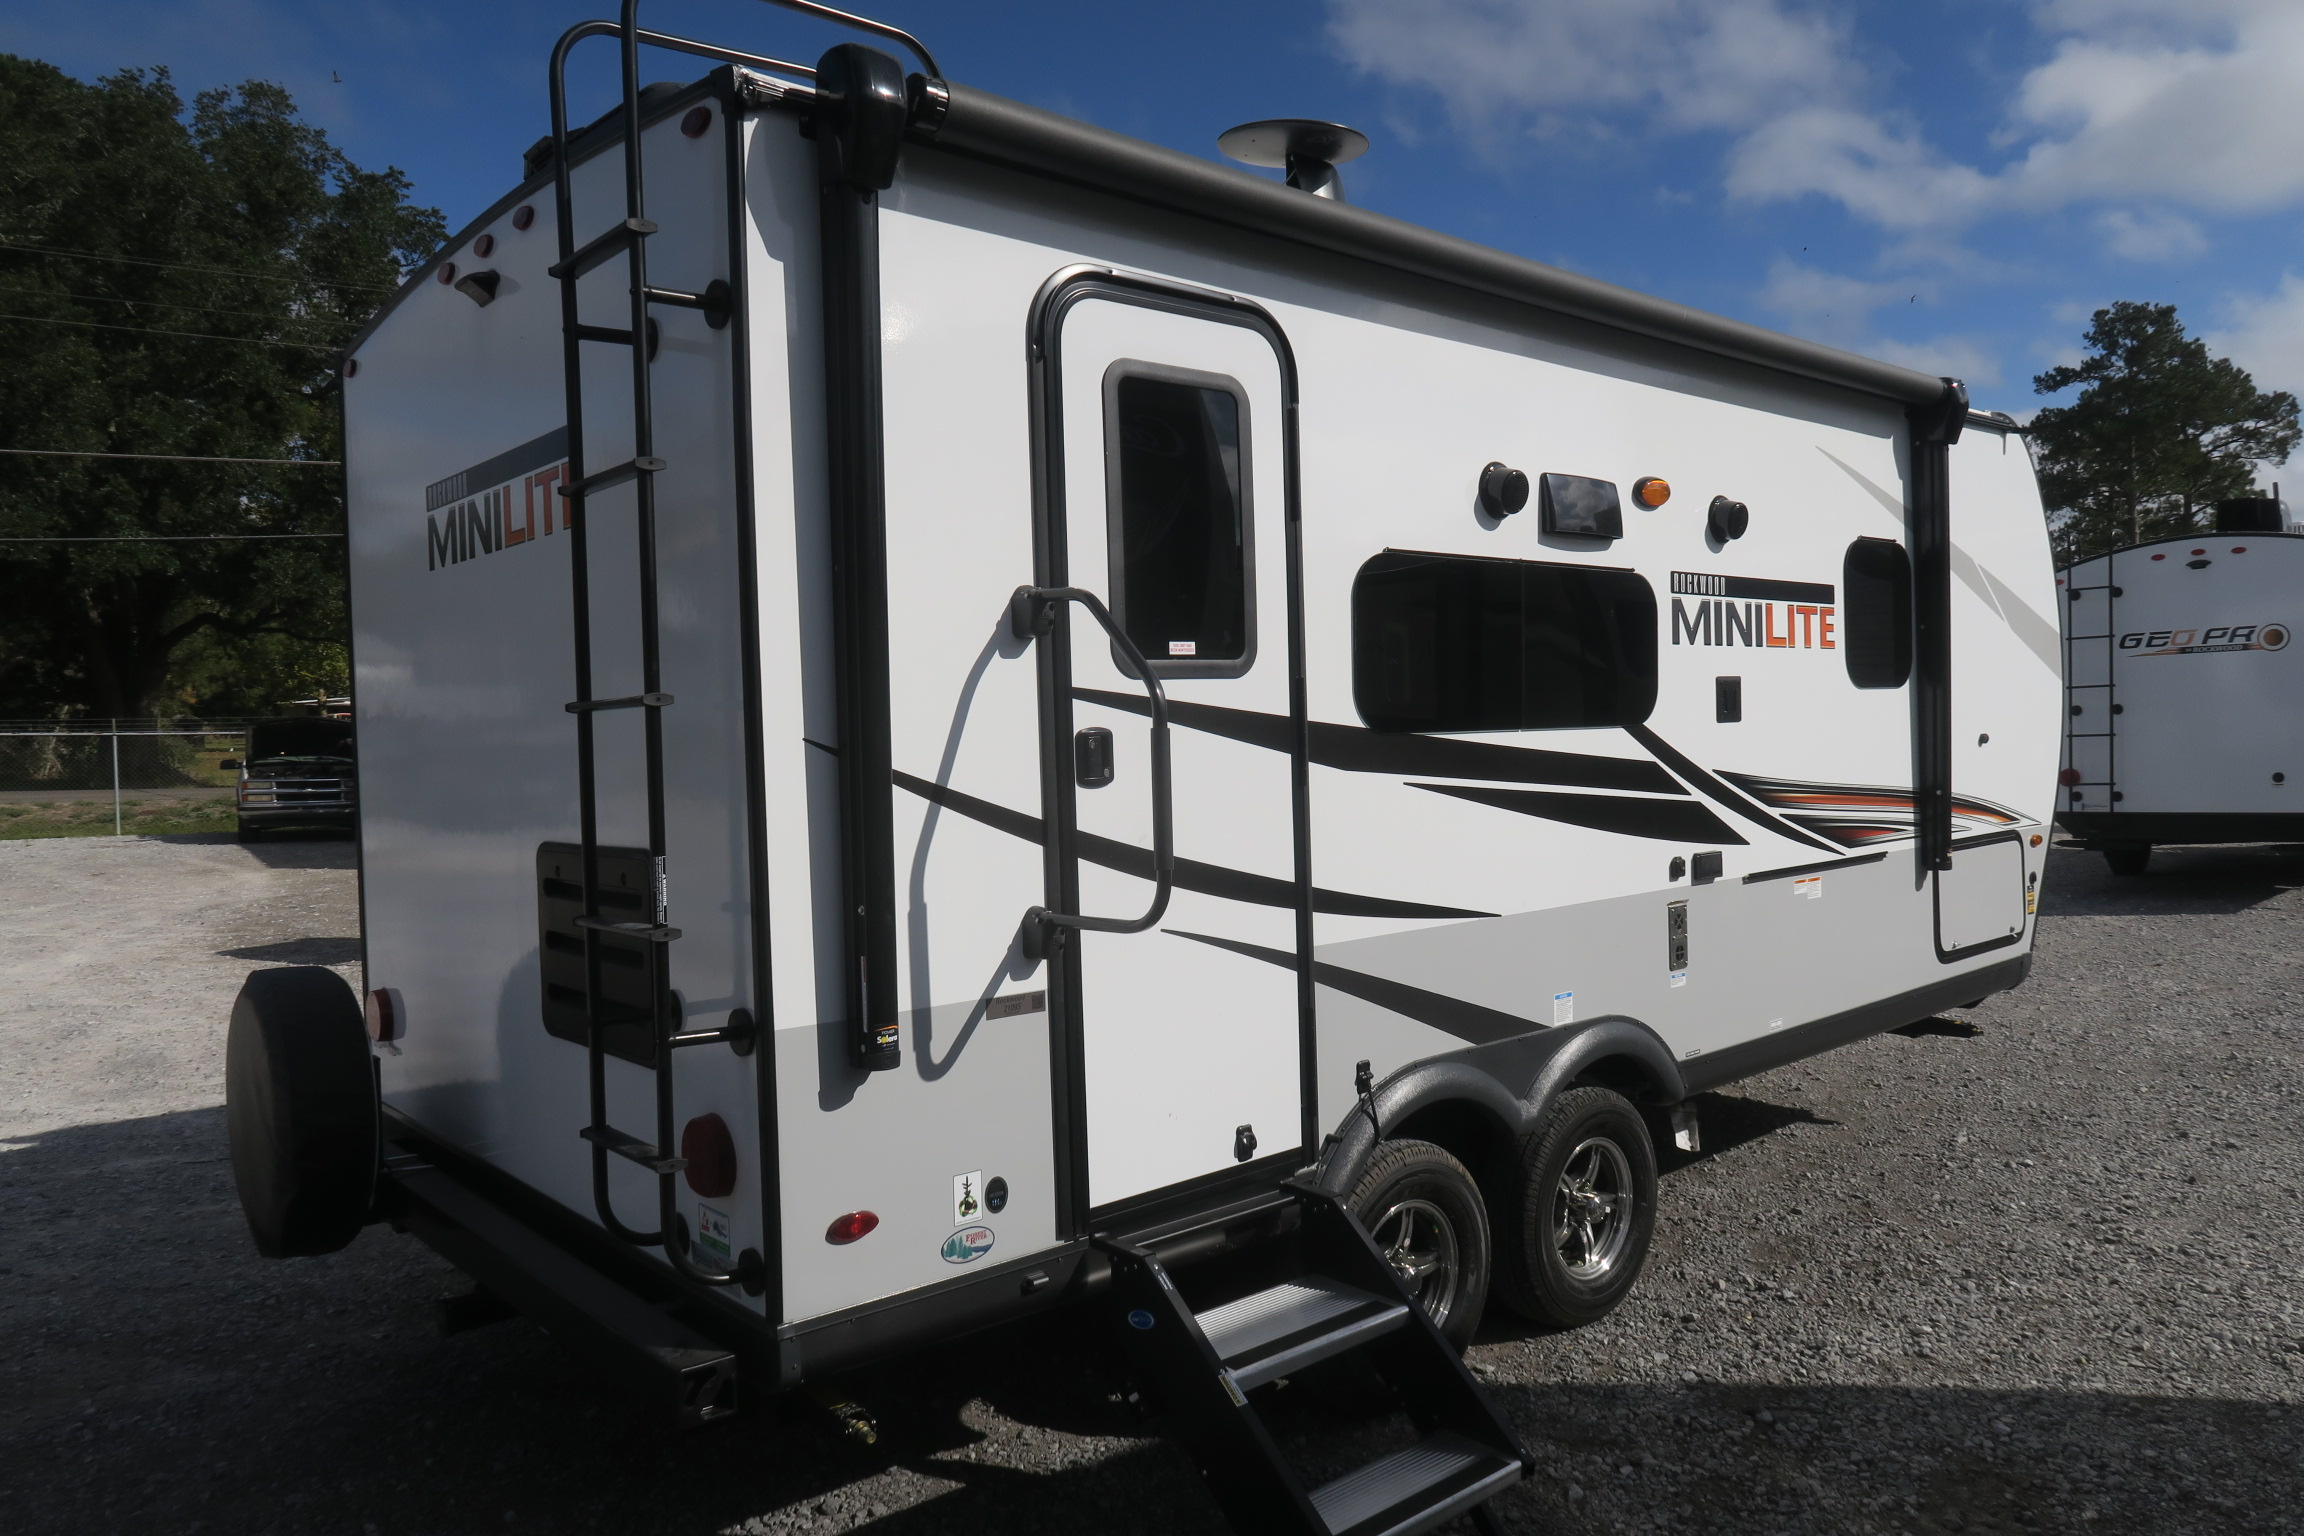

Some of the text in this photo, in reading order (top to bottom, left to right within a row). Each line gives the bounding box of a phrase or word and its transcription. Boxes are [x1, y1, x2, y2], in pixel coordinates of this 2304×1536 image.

[1673, 572, 1726, 596] ROCKWOOD
[1671, 596, 1836, 649] MINILITE
[2118, 623, 2291, 651] GEO PRO
[2192, 644, 2243, 653] ROCKWOOD
